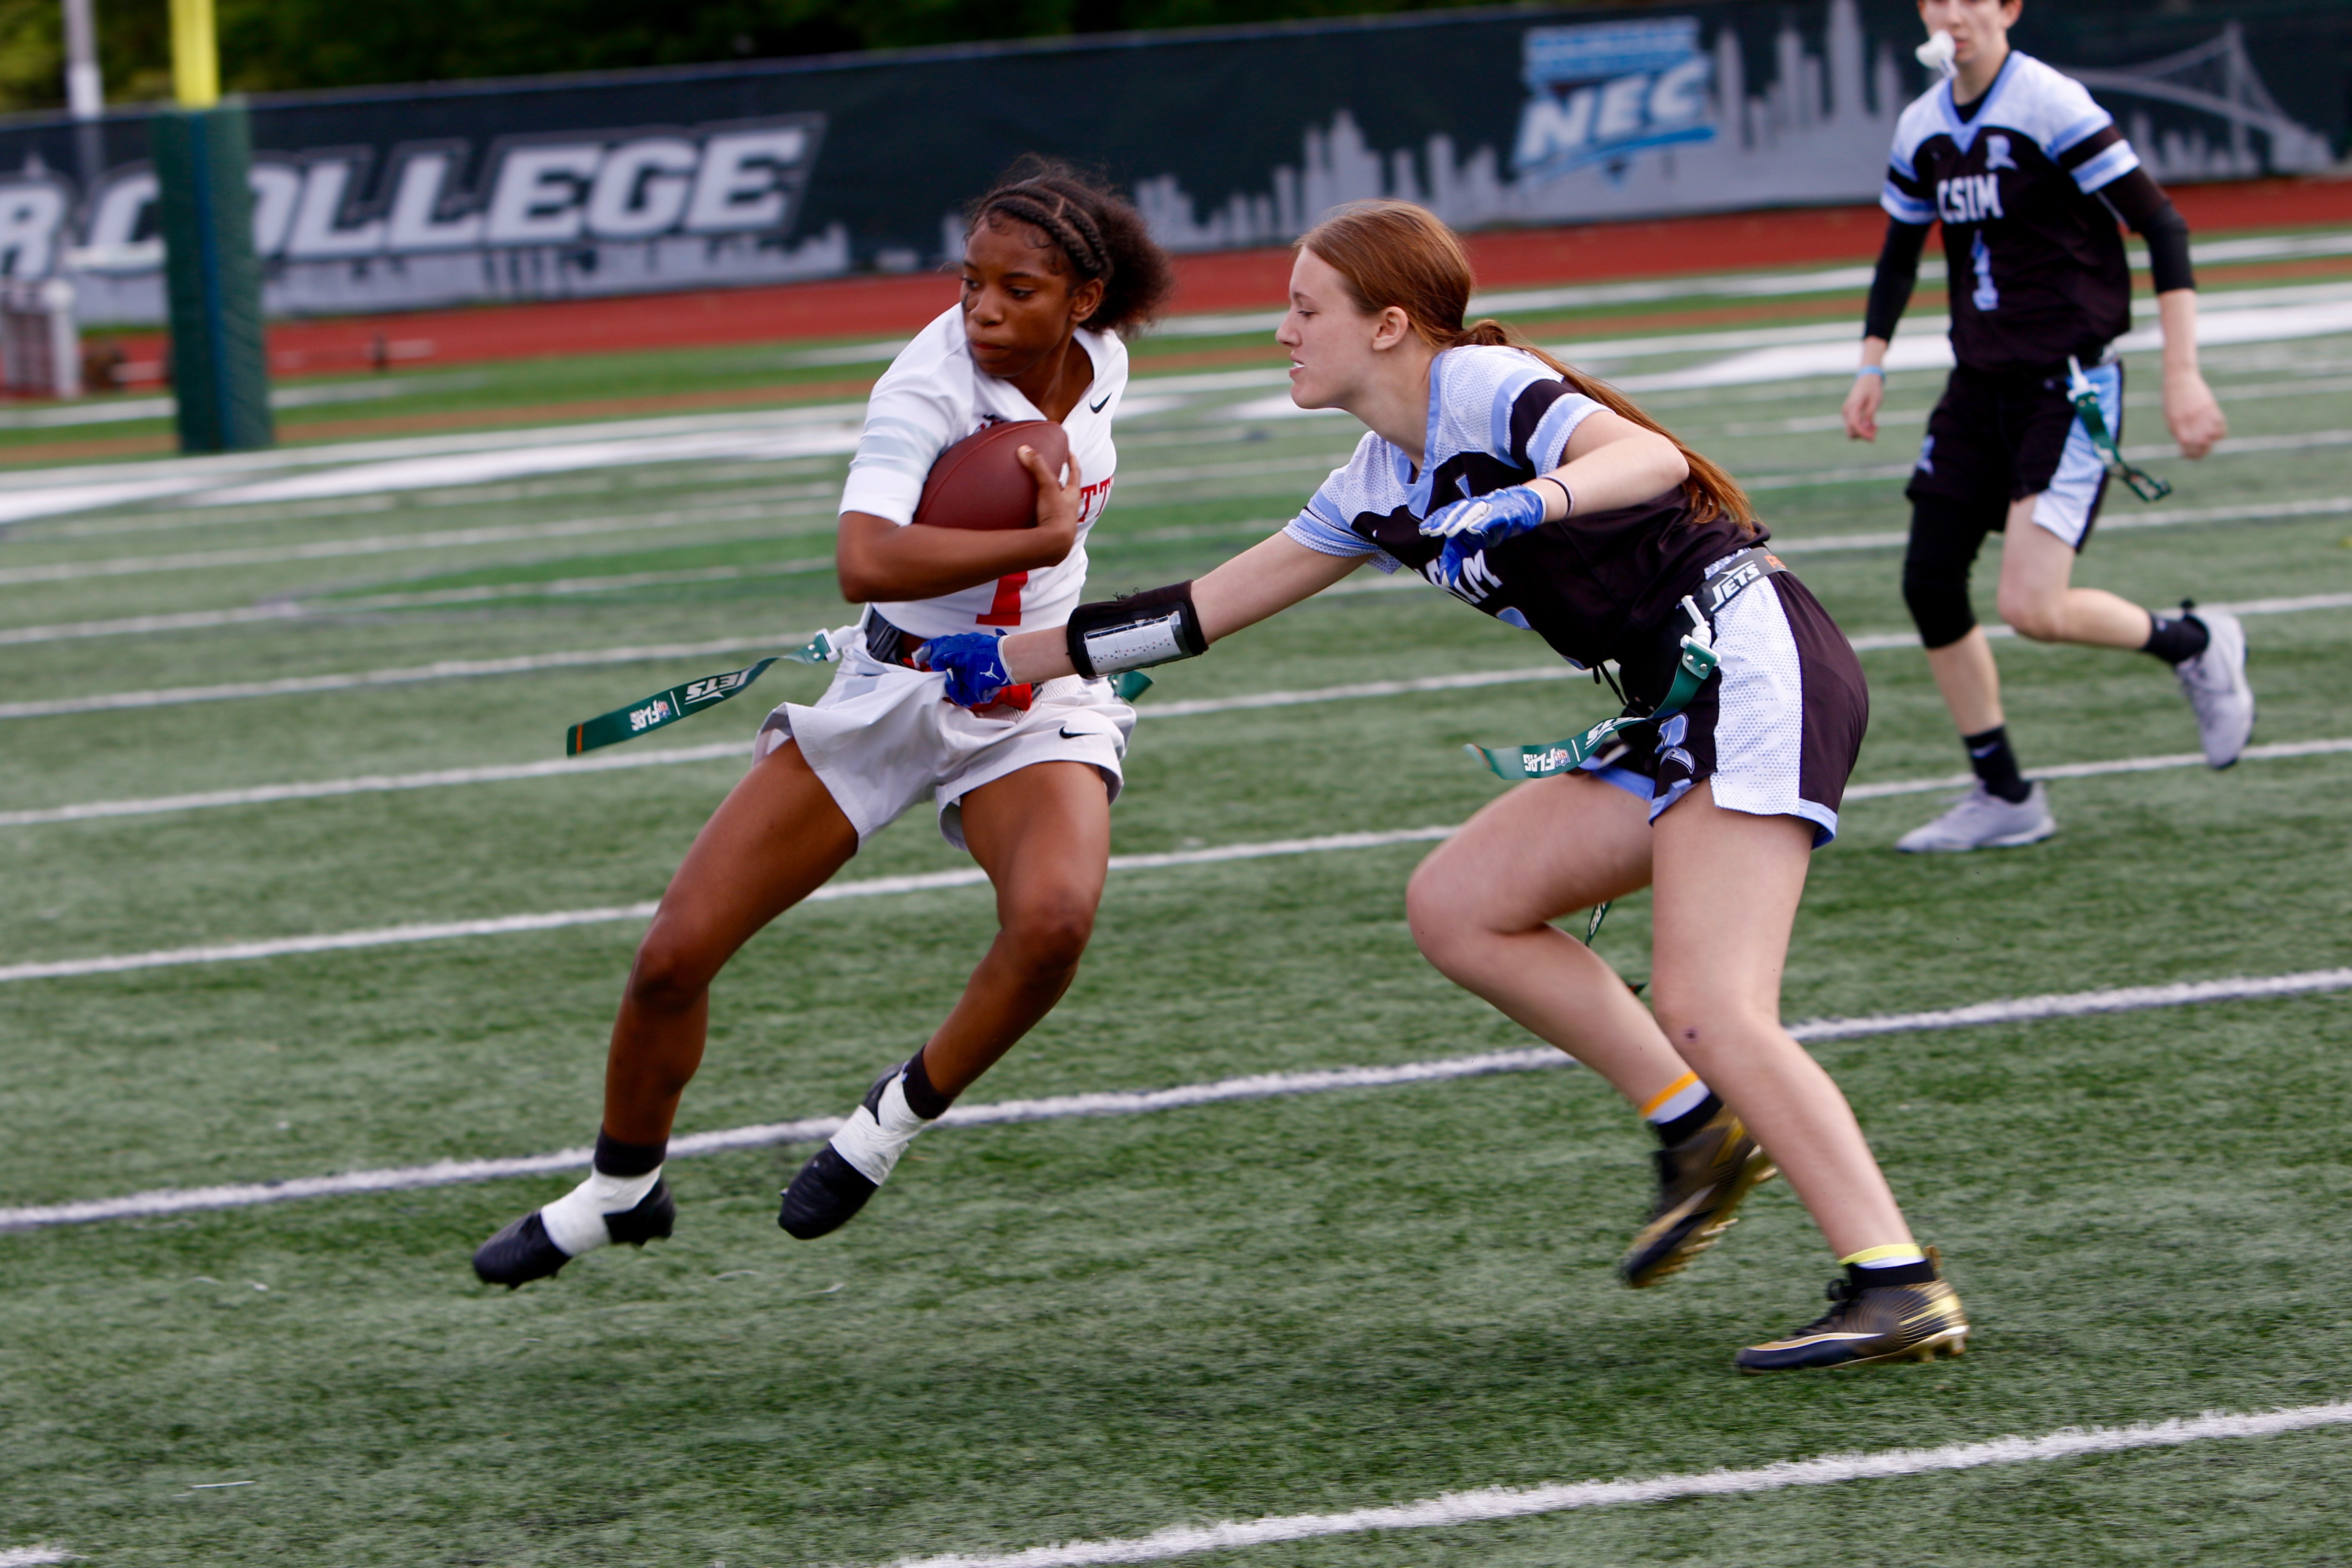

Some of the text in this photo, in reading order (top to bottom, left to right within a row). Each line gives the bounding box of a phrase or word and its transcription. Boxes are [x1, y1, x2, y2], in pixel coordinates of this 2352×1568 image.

[1513, 55, 1708, 165] NEC
[1937, 173, 2004, 224] CSIM
[1971, 230, 1998, 311] 1
[1709, 560, 1761, 612] JETS
[684, 664, 756, 705] JETS
[1522, 747, 1556, 772] FLAG
